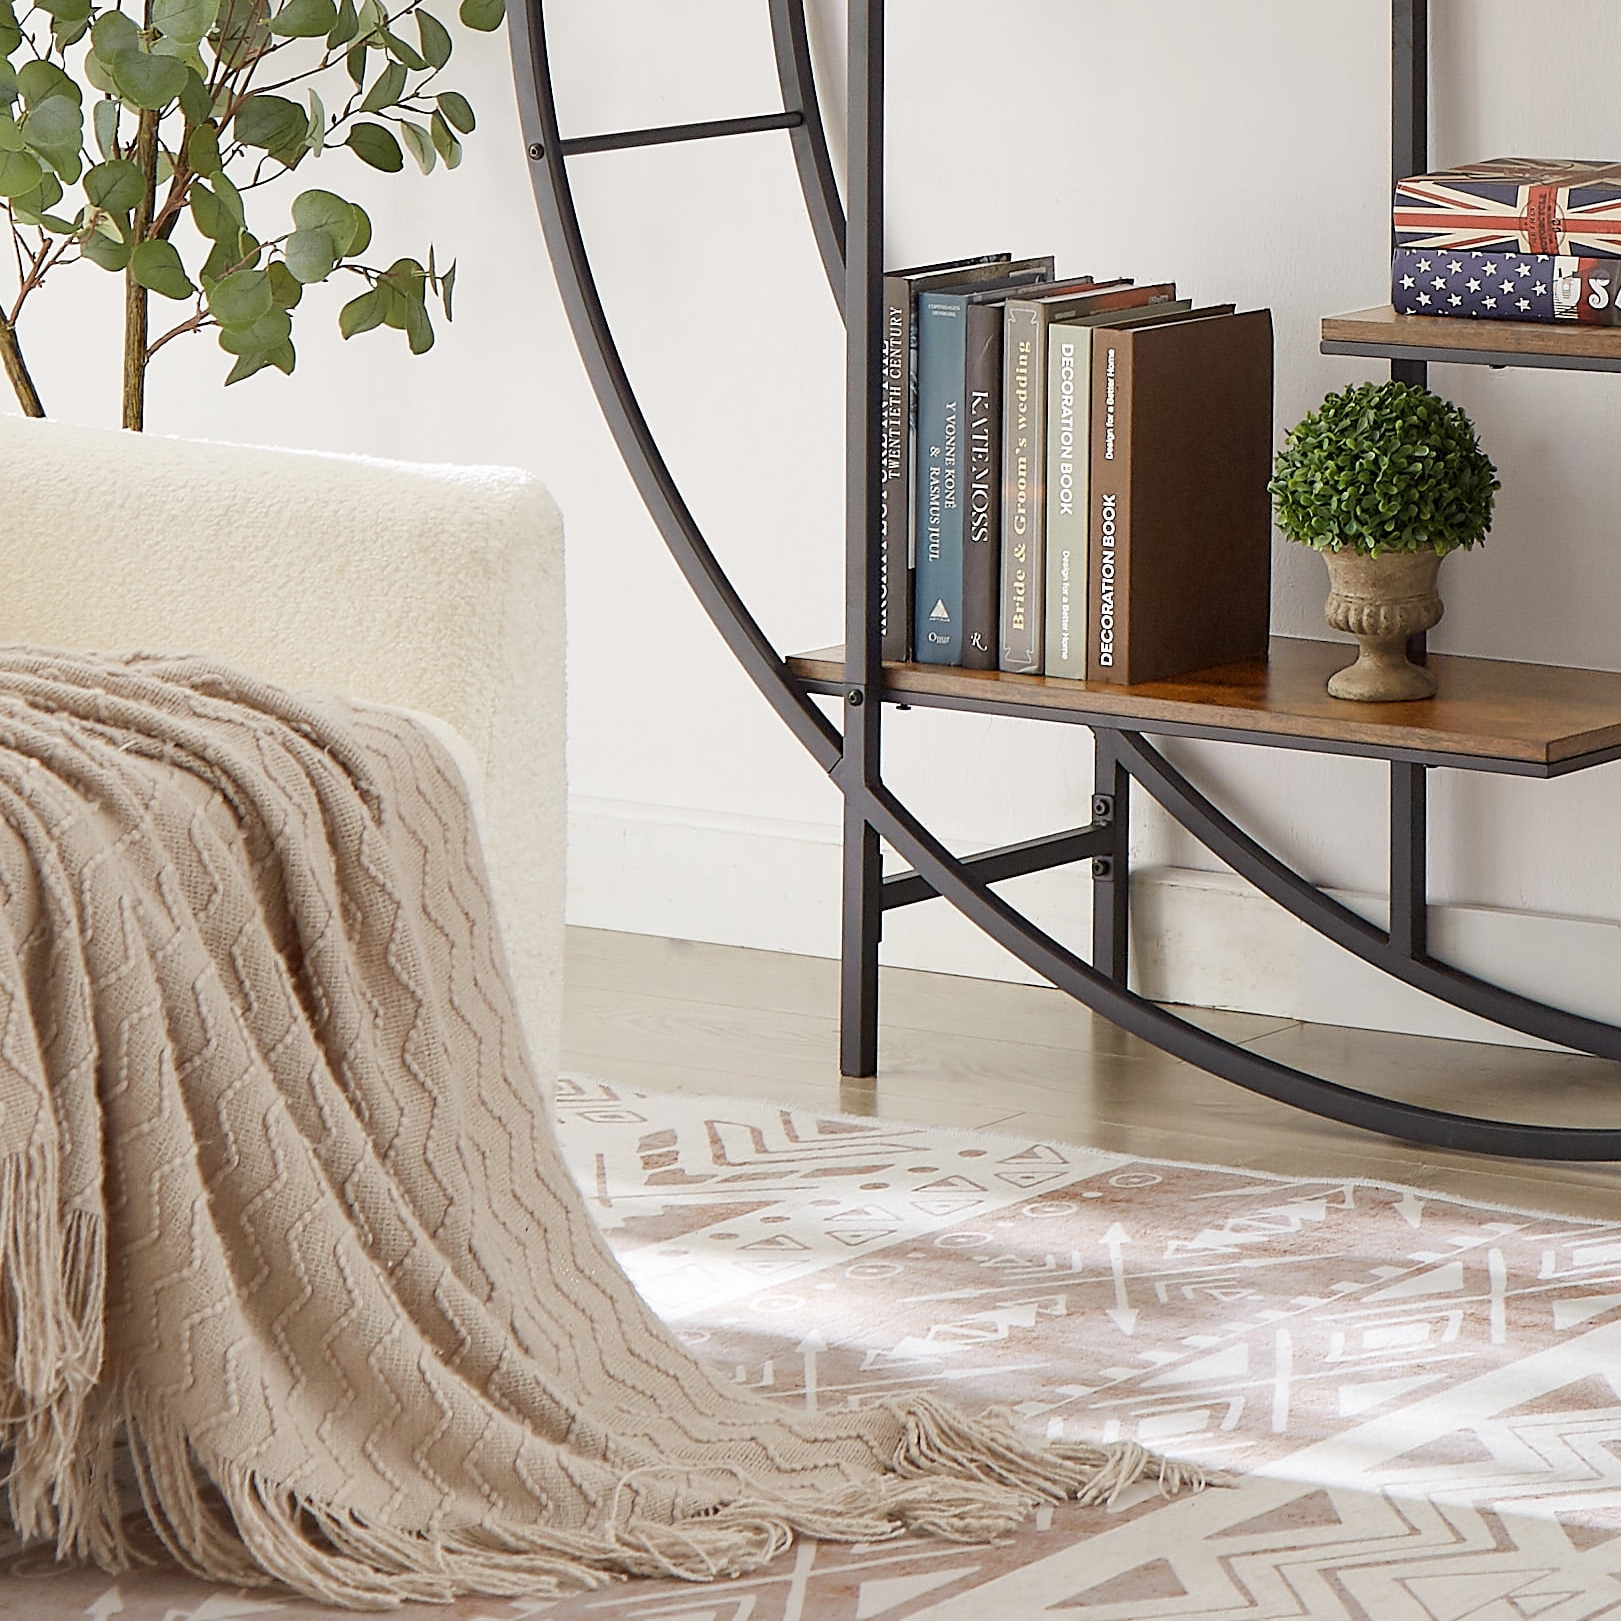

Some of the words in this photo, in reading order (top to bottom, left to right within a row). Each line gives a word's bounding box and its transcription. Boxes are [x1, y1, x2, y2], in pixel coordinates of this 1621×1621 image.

[889, 306, 903, 379] CENTURY
[1106, 348, 1115, 377] Home
[1014, 341, 1031, 430] wedding
[1060, 343, 1074, 459] DECORATION
[888, 384, 902, 479] TWENTIETH
[945, 401, 957, 466] YVONNE
[971, 391, 989, 462] KATE
[1106, 413, 1115, 427] for
[1106, 428, 1115, 460] Design
[929, 445, 941, 457] &
[928, 466, 941, 526] RASMUS
[1013, 437, 1028, 536] Groom's
[1059, 462, 1073, 515] BOOK
[928, 526, 941, 563] JUUL
[1101, 493, 1116, 548] BOOK
[1013, 542, 1026, 564] &
[1061, 550, 1071, 581] Design
[1012, 569, 1027, 631] Bride
[1061, 582, 1070, 596] for
[1100, 550, 1114, 667] DECORATION
[1061, 604, 1070, 631] Better
[1061, 632, 1070, 660] Home
